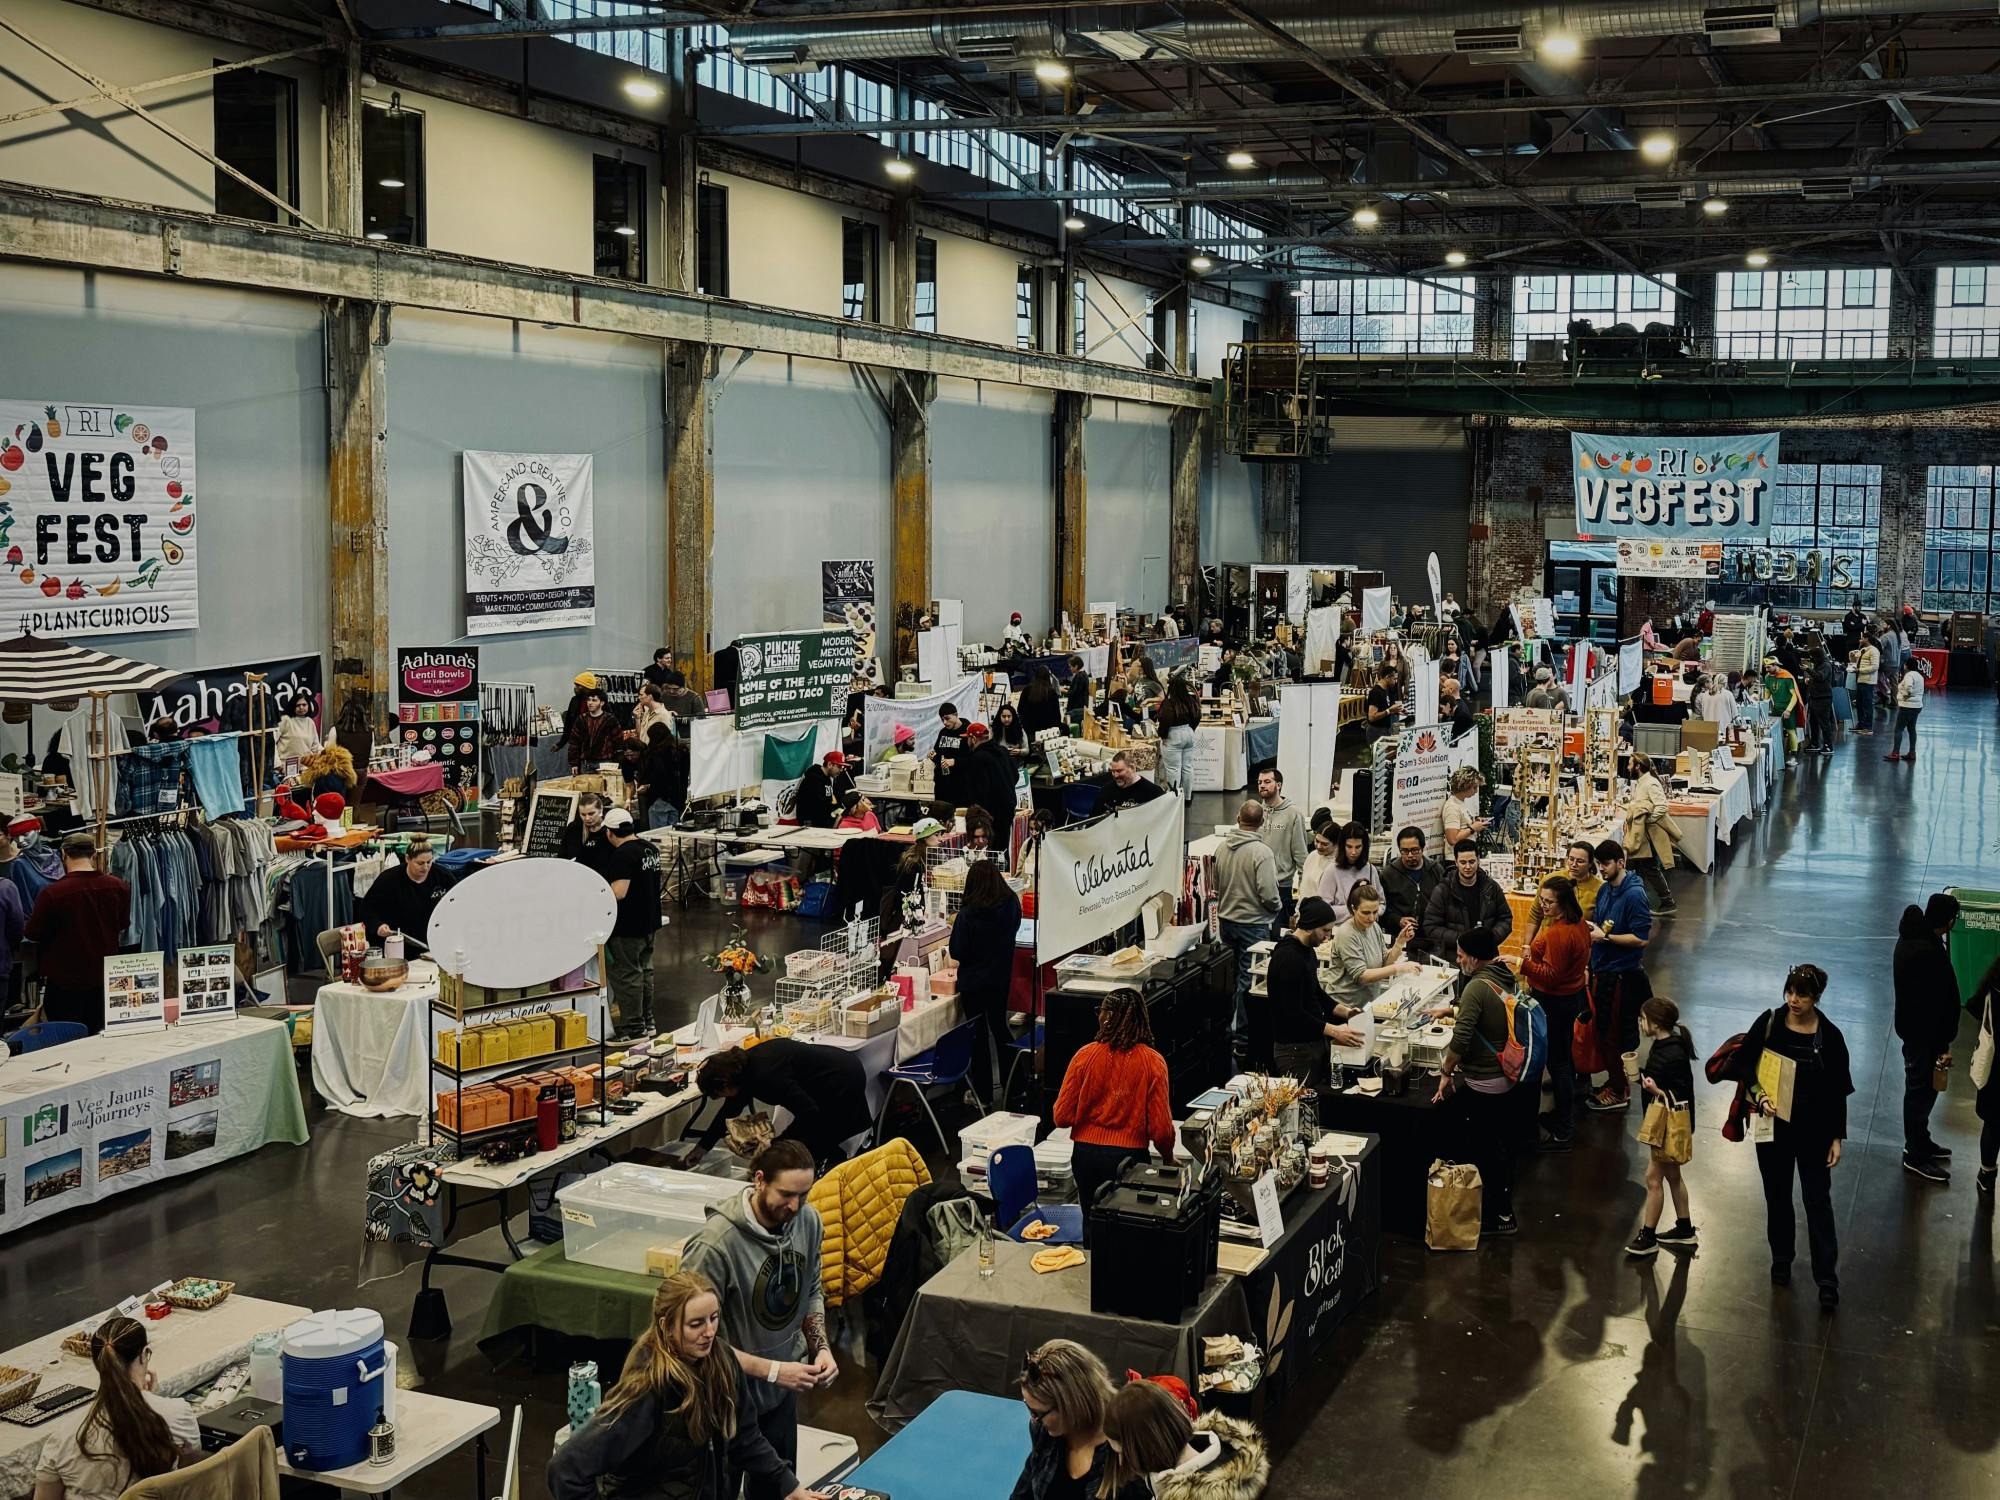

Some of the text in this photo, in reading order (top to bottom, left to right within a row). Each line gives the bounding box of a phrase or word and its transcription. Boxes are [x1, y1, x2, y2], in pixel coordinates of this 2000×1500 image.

[80, 410, 101, 432] RI
[1656, 448, 1687, 477] RI
[45, 452, 135, 502] VEG
[491, 462, 526, 532] AMPERSAND
[530, 461, 567, 505] CREATIVE
[1578, 477, 1768, 527] VEGFEST
[36, 514, 148, 565] FEST
[476, 589, 580, 603] EVENTS PHOTO VIDEO DESIGN WEB
[485, 599, 572, 613] MARKETING COMMUNICATIONS
[19, 605, 170, 633] #PLANTCURIOUS
[765, 640, 801, 655] PINCHE
[401, 651, 476, 672] Aahana's
[765, 653, 800, 668] VEGANA
[808, 659, 833, 670] VEGAN
[834, 658, 855, 668] FARE
[411, 669, 465, 680] Lentil Bowls
[739, 680, 767, 694] HOME
[770, 679, 782, 690] OF
[784, 677, 805, 688] THE
[807, 675, 819, 687] #1
[740, 693, 765, 707] DEEP
[799, 687, 824, 699] TACO
[1400, 758, 1417, 769] Sam's
[1074, 834, 1154, 896] Celebrated
[1078, 901, 1102, 915] Elevated
[1101, 888, 1131, 906] Plant-Based
[76, 1086, 154, 1114] Veg Jaunts
[72, 1101, 151, 1129] and Journeys
